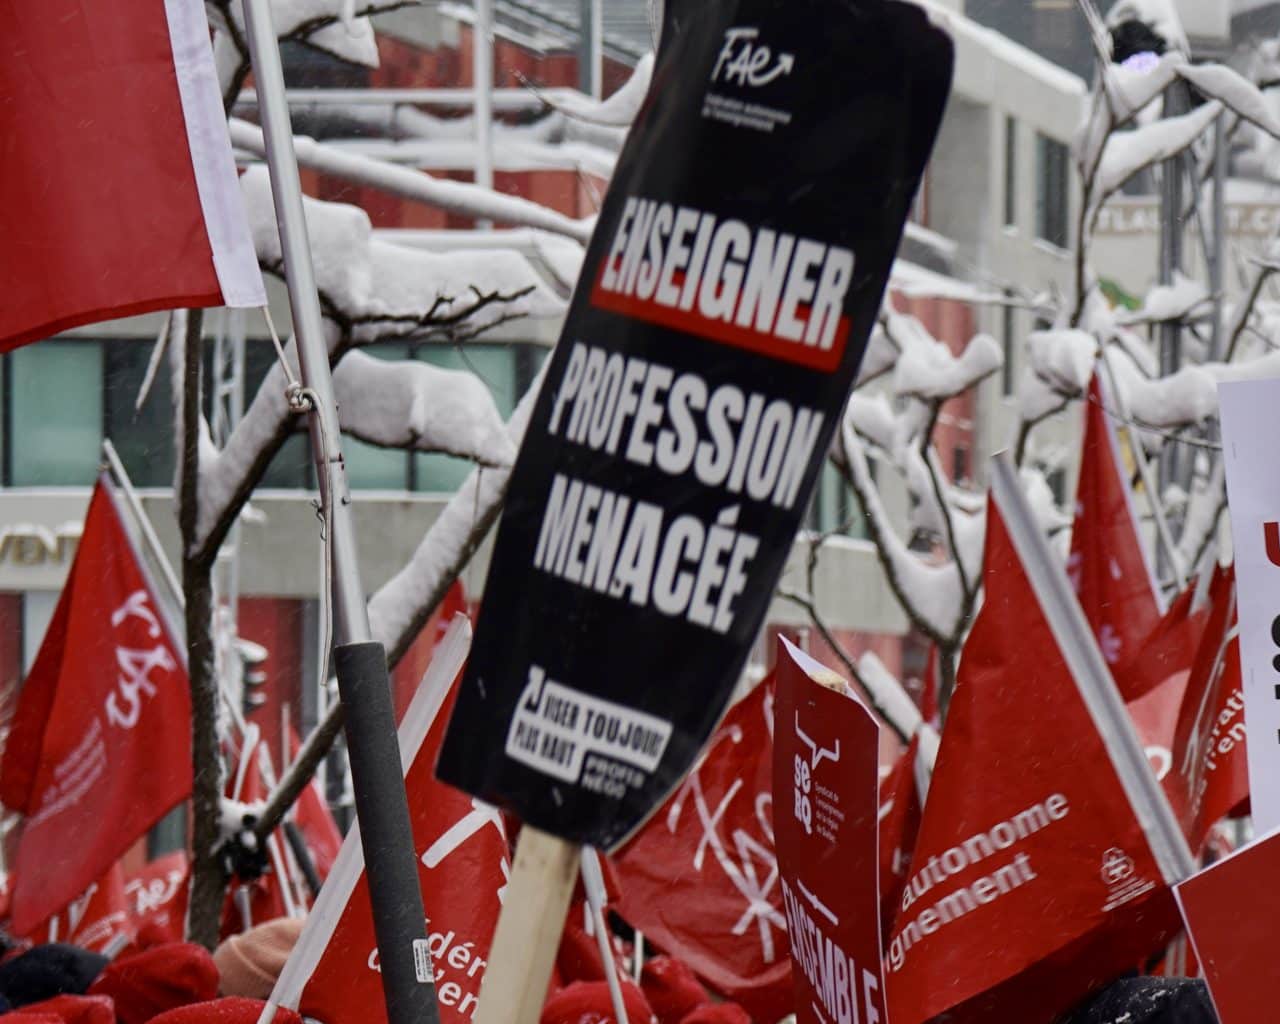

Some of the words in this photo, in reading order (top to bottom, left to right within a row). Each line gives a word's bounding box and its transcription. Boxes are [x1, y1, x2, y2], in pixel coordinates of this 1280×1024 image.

[601, 196, 855, 351] ENSEIGNER
[548, 342, 824, 510] PROFESSION
[533, 473, 760, 634] MENACÉE
[887, 851, 1038, 973] gnement
[901, 792, 1071, 913] autonome
